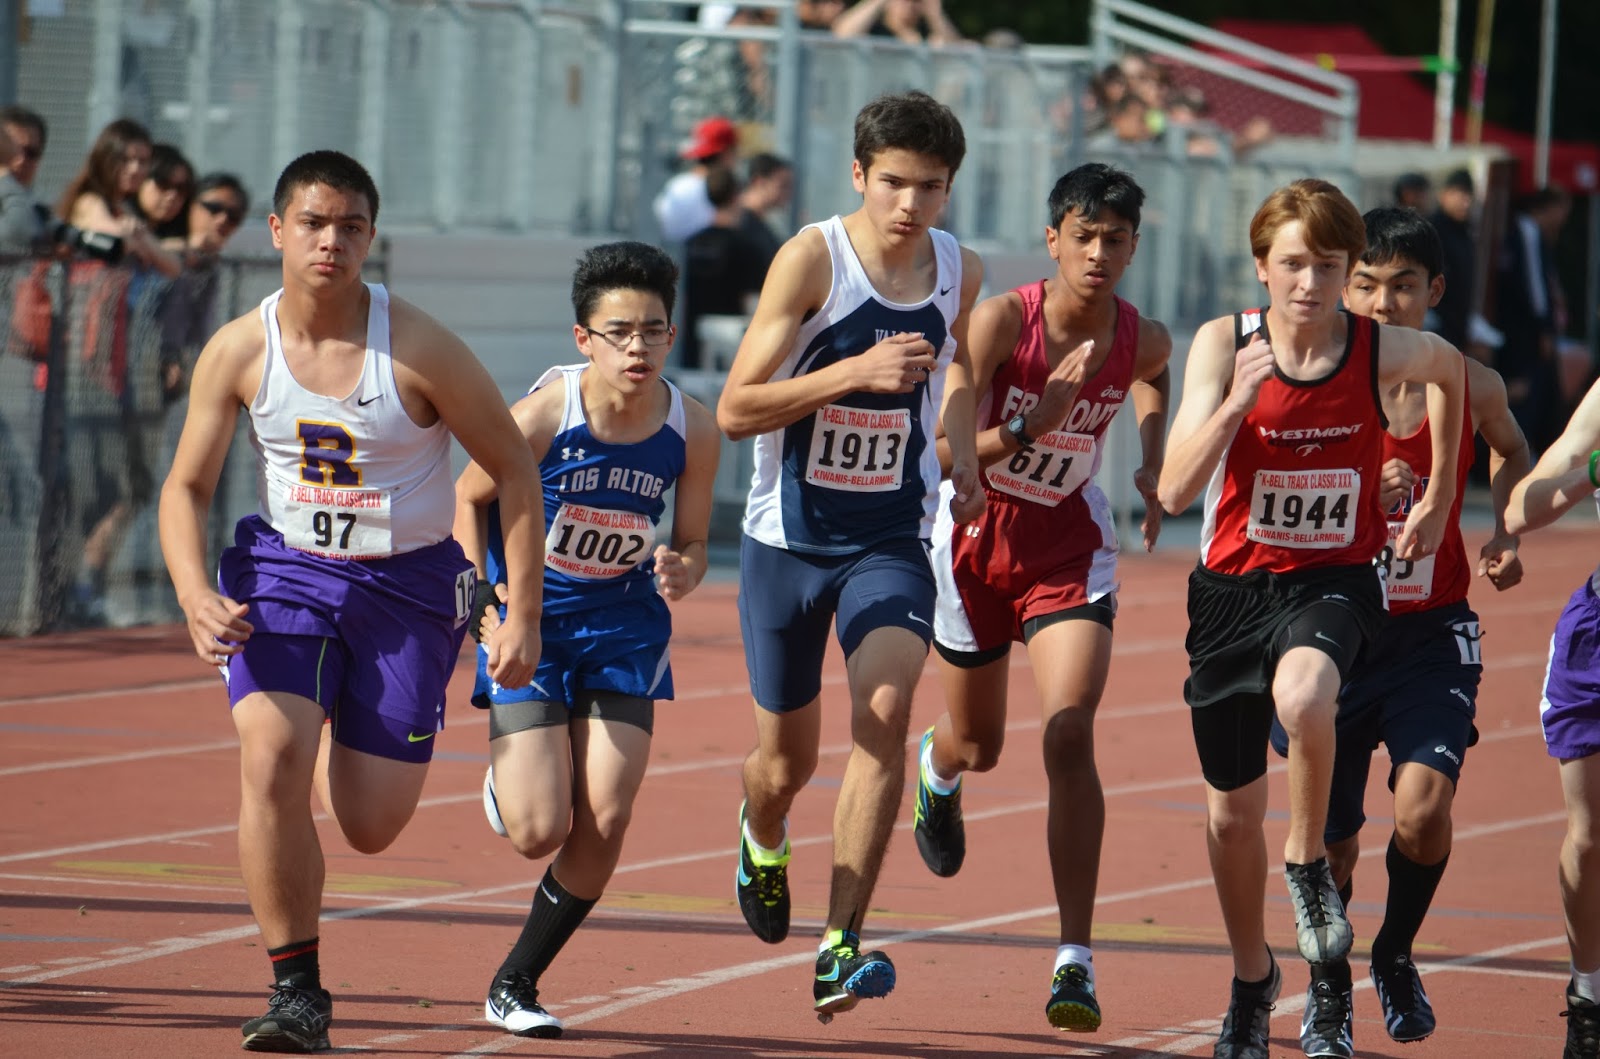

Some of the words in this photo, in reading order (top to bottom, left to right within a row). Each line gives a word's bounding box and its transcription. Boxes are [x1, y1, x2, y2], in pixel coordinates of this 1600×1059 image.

[823, 408, 846, 425] K-BELL
[848, 412, 869, 428] TRACK
[870, 413, 895, 429] CLASSIC
[894, 413, 906, 429] XXX
[1001, 385, 1123, 433] FRONT
[1057, 435, 1081, 452] CLASSIC
[1259, 423, 1364, 440] WESTMONT
[296, 418, 363, 488] R
[818, 429, 901, 472] 1913
[813, 469, 895, 486] KIWANIS-BELLARMINE
[1009, 445, 1073, 488] 611
[559, 467, 600, 493] LOS
[607, 467, 664, 499] ALTOS
[990, 472, 1068, 502] KIWANIS-BELLARMIN
[1262, 473, 1285, 488] K-BELL
[1287, 475, 1309, 490] TRACK
[1310, 473, 1336, 489] CLASSIC
[1337, 472, 1352, 488] XXX
[313, 487, 335, 506] TRACK
[336, 490, 364, 508] CLASSIC
[366, 492, 381, 508] XXX
[1259, 492, 1349, 530] 1944
[313, 511, 356, 549] 97
[565, 505, 589, 522] K-BELL
[589, 511, 611, 527] TRACK
[611, 513, 636, 529] CLASSIC
[636, 515, 649, 530] XXX
[553, 524, 645, 566] 1002
[1254, 527, 1345, 543] KIWANIS-BELLARMINE
[1444, 749, 1460, 765] asics
